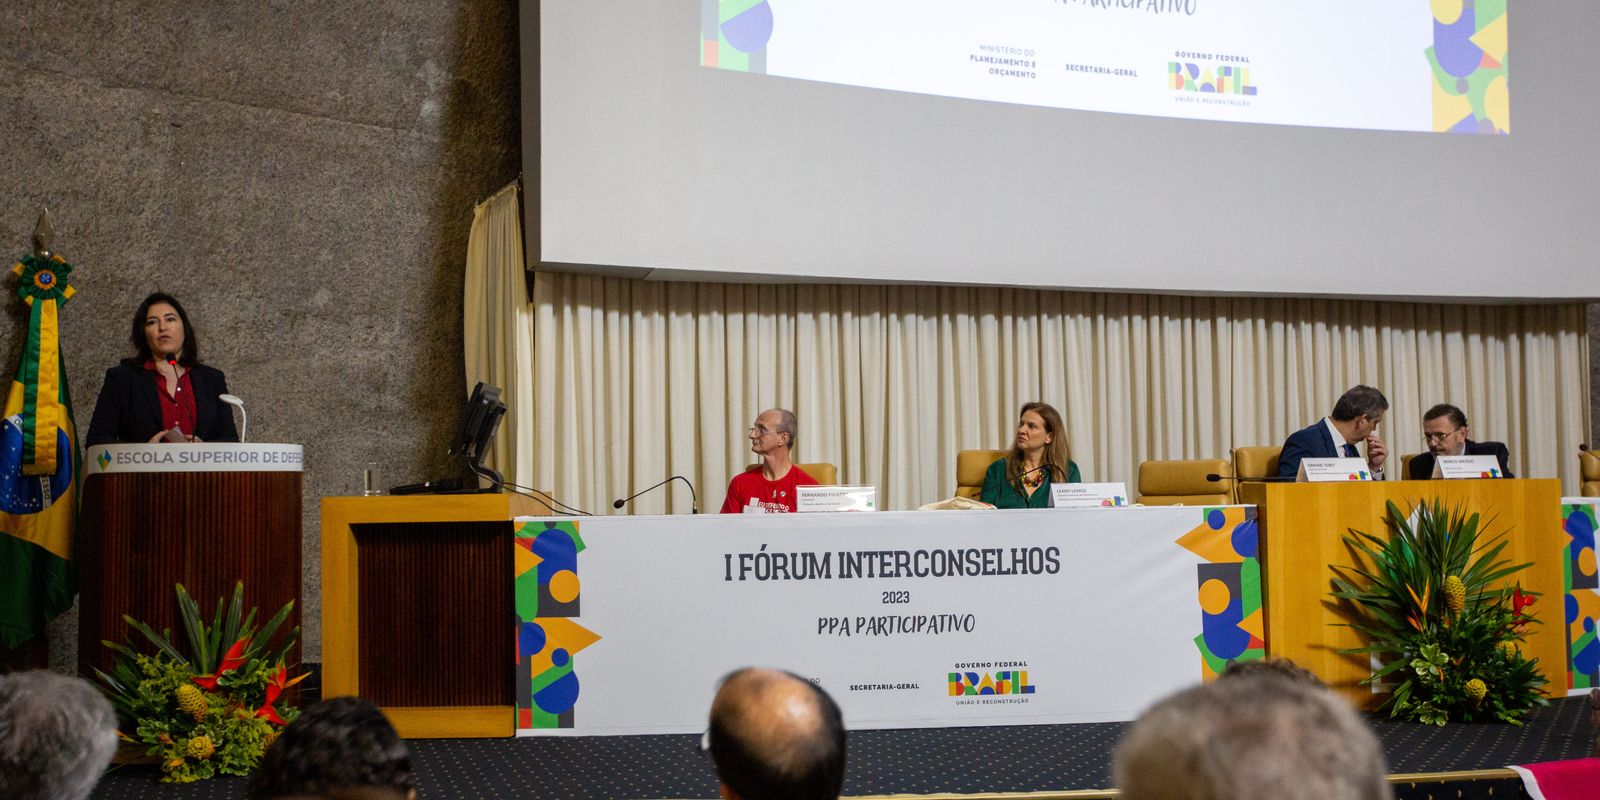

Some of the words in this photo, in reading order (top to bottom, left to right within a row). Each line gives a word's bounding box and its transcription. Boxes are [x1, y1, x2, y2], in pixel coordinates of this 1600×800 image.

[979, 44, 1022, 56] MINISTÉRIO
[1024, 49, 1036, 57] DO
[1175, 51, 1213, 60] GOVERNO
[1215, 54, 1250, 63] FEDERAL
[970, 54, 1030, 67] PLANEJAMENTO
[988, 67, 1036, 79] ORÇAMENTO
[1065, 63, 1138, 77] SECRETARIA-GERAL
[1167, 61, 1257, 96] BRASIL
[1174, 95, 1194, 103] UNIÃO
[1202, 98, 1251, 107] RECONSTRUÇÃO
[117, 451, 174, 464] ESCOLA
[179, 451, 259, 463] SUPERIOR
[263, 451, 279, 463] DE
[725, 553, 732, 581] I
[738, 543, 832, 581] FÓRUM
[838, 546, 1061, 579] INTERCONSELHOS
[882, 591, 910, 604] 2023
[817, 616, 851, 637] PPA
[855, 613, 976, 637] PARTICIPATIVO
[850, 683, 920, 691] SECRETARIA-GERAL
[948, 671, 1036, 696] BRASIL
[956, 698, 975, 706] UNIÃO
[982, 697, 1029, 706] RECONSTRUÇÃO
